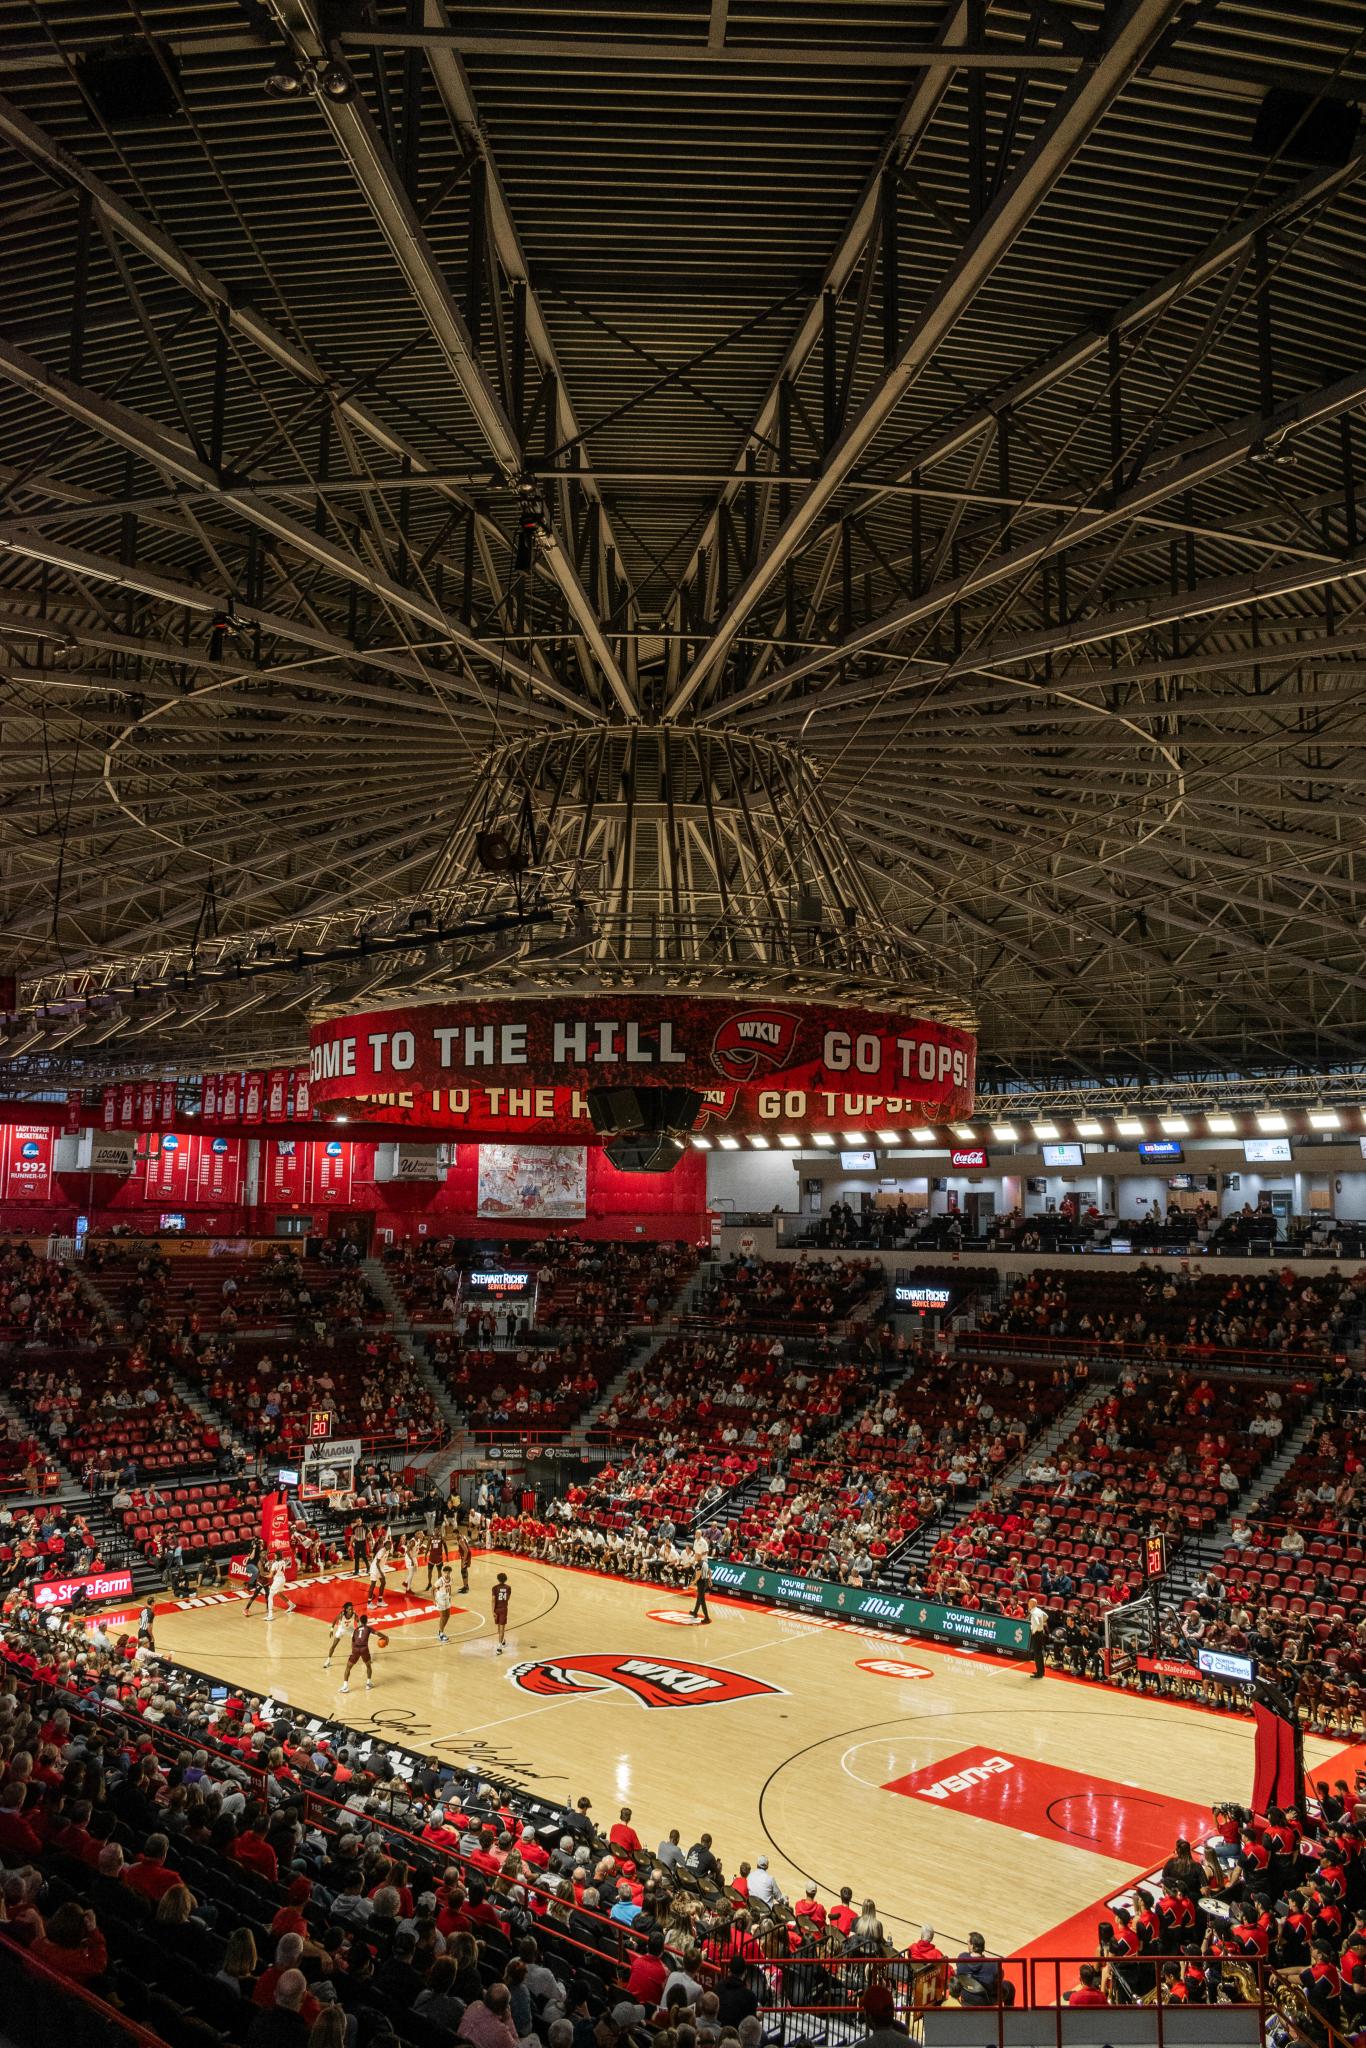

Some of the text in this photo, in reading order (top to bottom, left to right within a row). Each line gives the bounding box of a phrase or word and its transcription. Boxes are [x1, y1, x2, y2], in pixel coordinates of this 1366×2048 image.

[737, 1021, 782, 1044] WKU
[368, 1031, 415, 1072] TO
[433, 1024, 527, 1067] THE
[553, 1022, 686, 1063] HILL
[823, 1031, 967, 1088] GO TOPS!
[485, 1088, 555, 1117] THE
[758, 1090, 806, 1119] GO
[96, 1149, 122, 1159] LOGAN
[15, 1162, 47, 1173] 1992
[472, 1274, 528, 1284] STEWART RICHEY
[896, 1288, 949, 1301] STEWART RICHEY
[313, 1422, 326, 1435] 20
[1148, 1552, 1160, 1573] 20
[777, 1587, 823, 1602] TO WIN HERE!
[780, 1578, 823, 1593] YOU'RE MINT
[942, 1620, 997, 1639] TO WIN HERE!
[945, 1612, 996, 1629] YOU'RE MINT
[837, 1624, 912, 1643] ARENA
[615, 1659, 725, 1694] WKU
[858, 1660, 932, 1678] IGA
[1215, 1662, 1250, 1677] Children's
[922, 1977, 937, 2005] H
